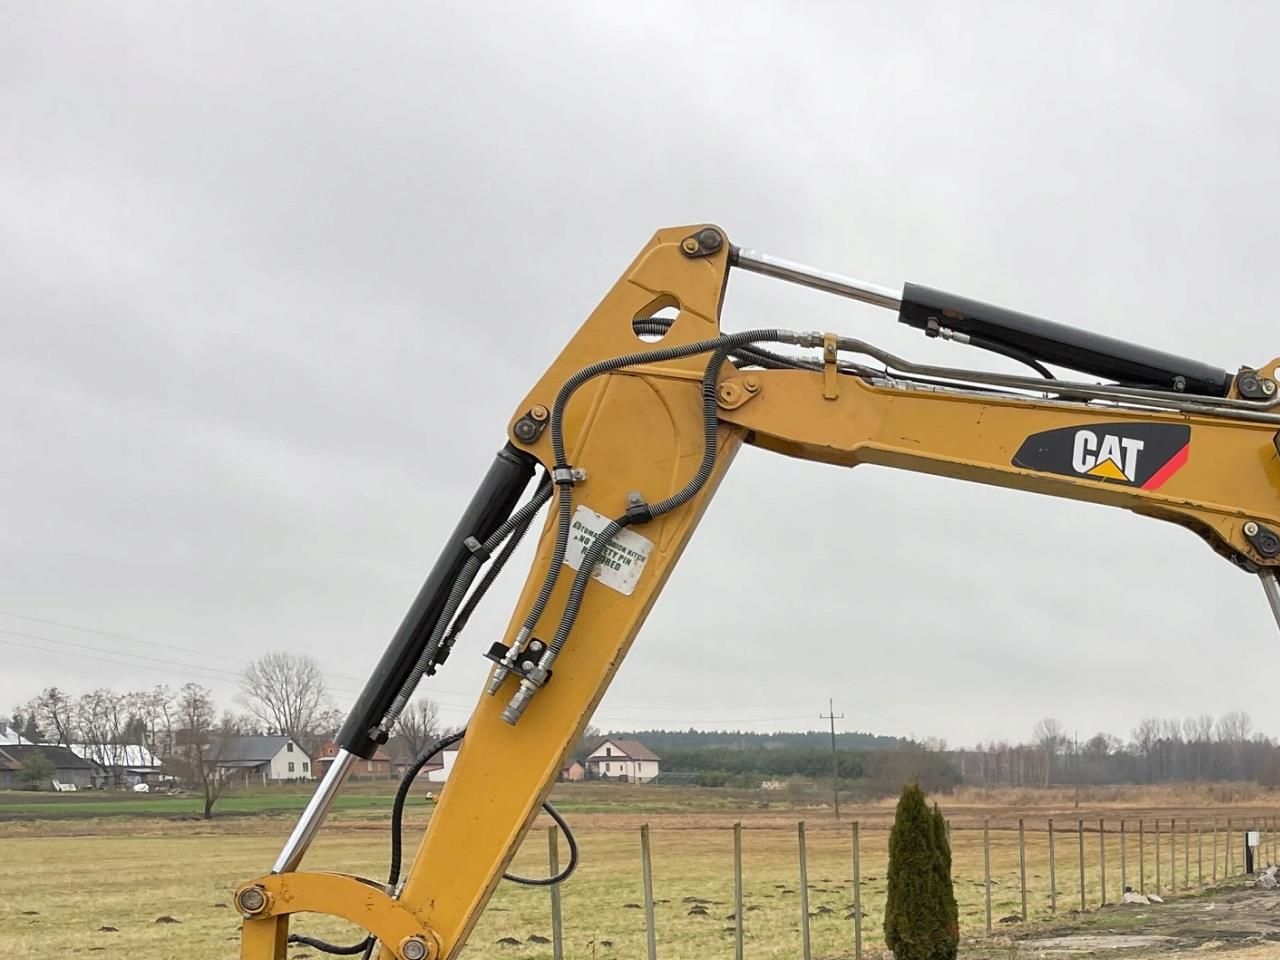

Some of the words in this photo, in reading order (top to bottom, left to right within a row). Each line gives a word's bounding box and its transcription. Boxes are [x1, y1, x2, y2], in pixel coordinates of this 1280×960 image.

[1072, 430, 1145, 482] CAT
[578, 534, 591, 546] NO
[617, 554, 633, 567] PIN
